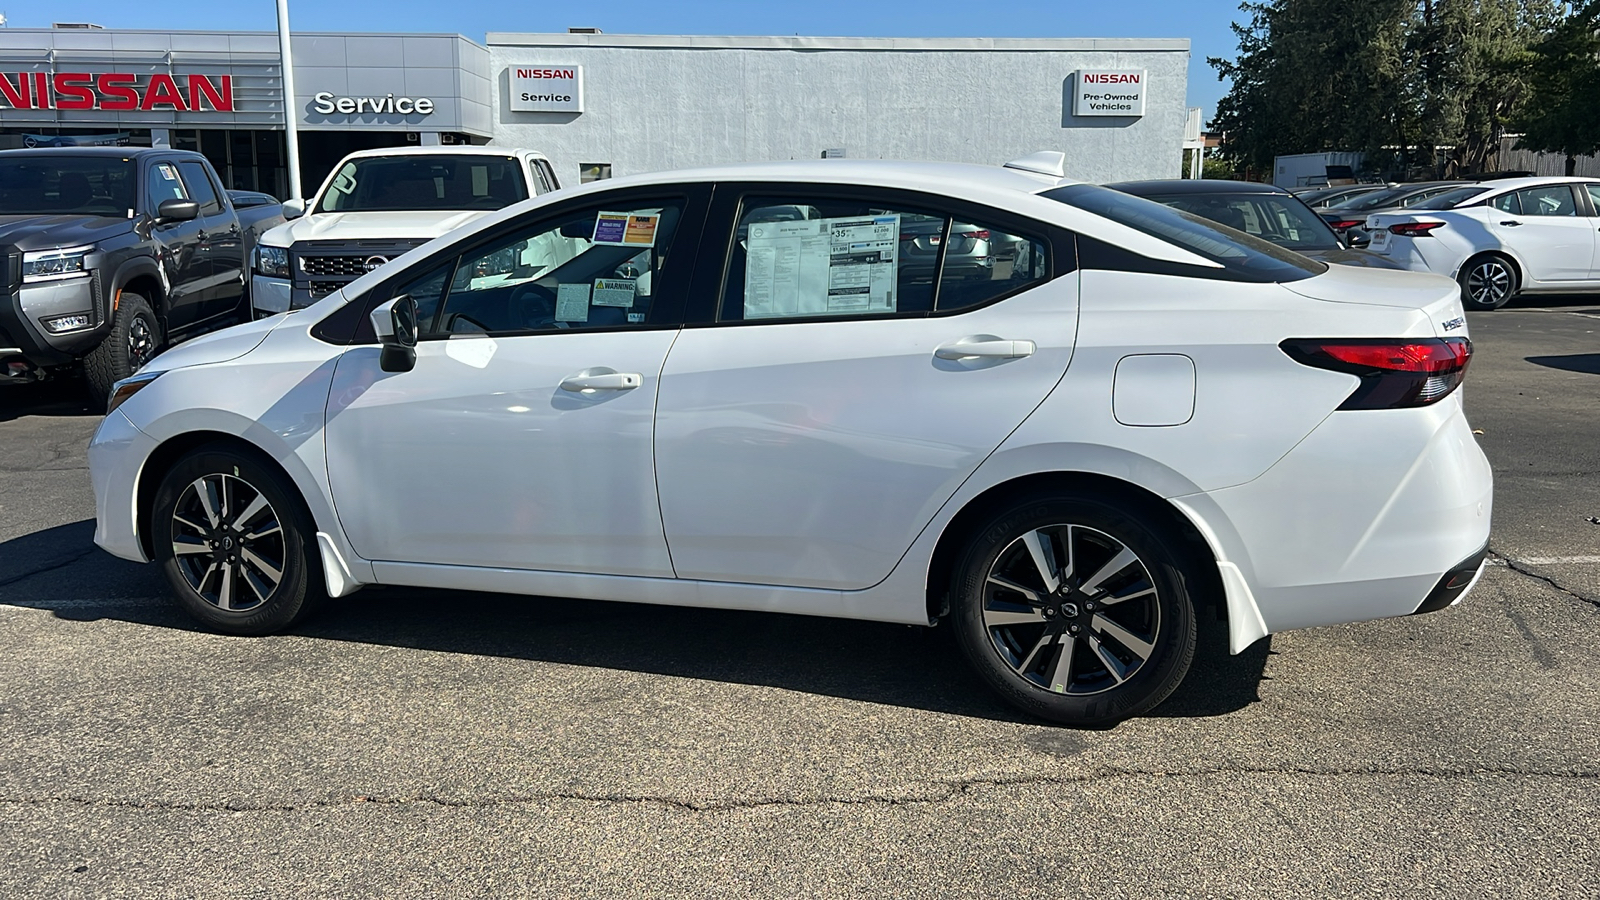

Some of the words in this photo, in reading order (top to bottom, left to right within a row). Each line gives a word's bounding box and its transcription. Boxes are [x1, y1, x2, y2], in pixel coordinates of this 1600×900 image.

[516, 69, 574, 79] NISSAN
[1084, 74, 1140, 84] NISSAN
[0, 72, 234, 112] NISSAN
[521, 92, 572, 102] Service
[1083, 93, 1139, 101] Pre-Owned
[314, 91, 434, 114] Service
[835, 229, 846, 238] 35
